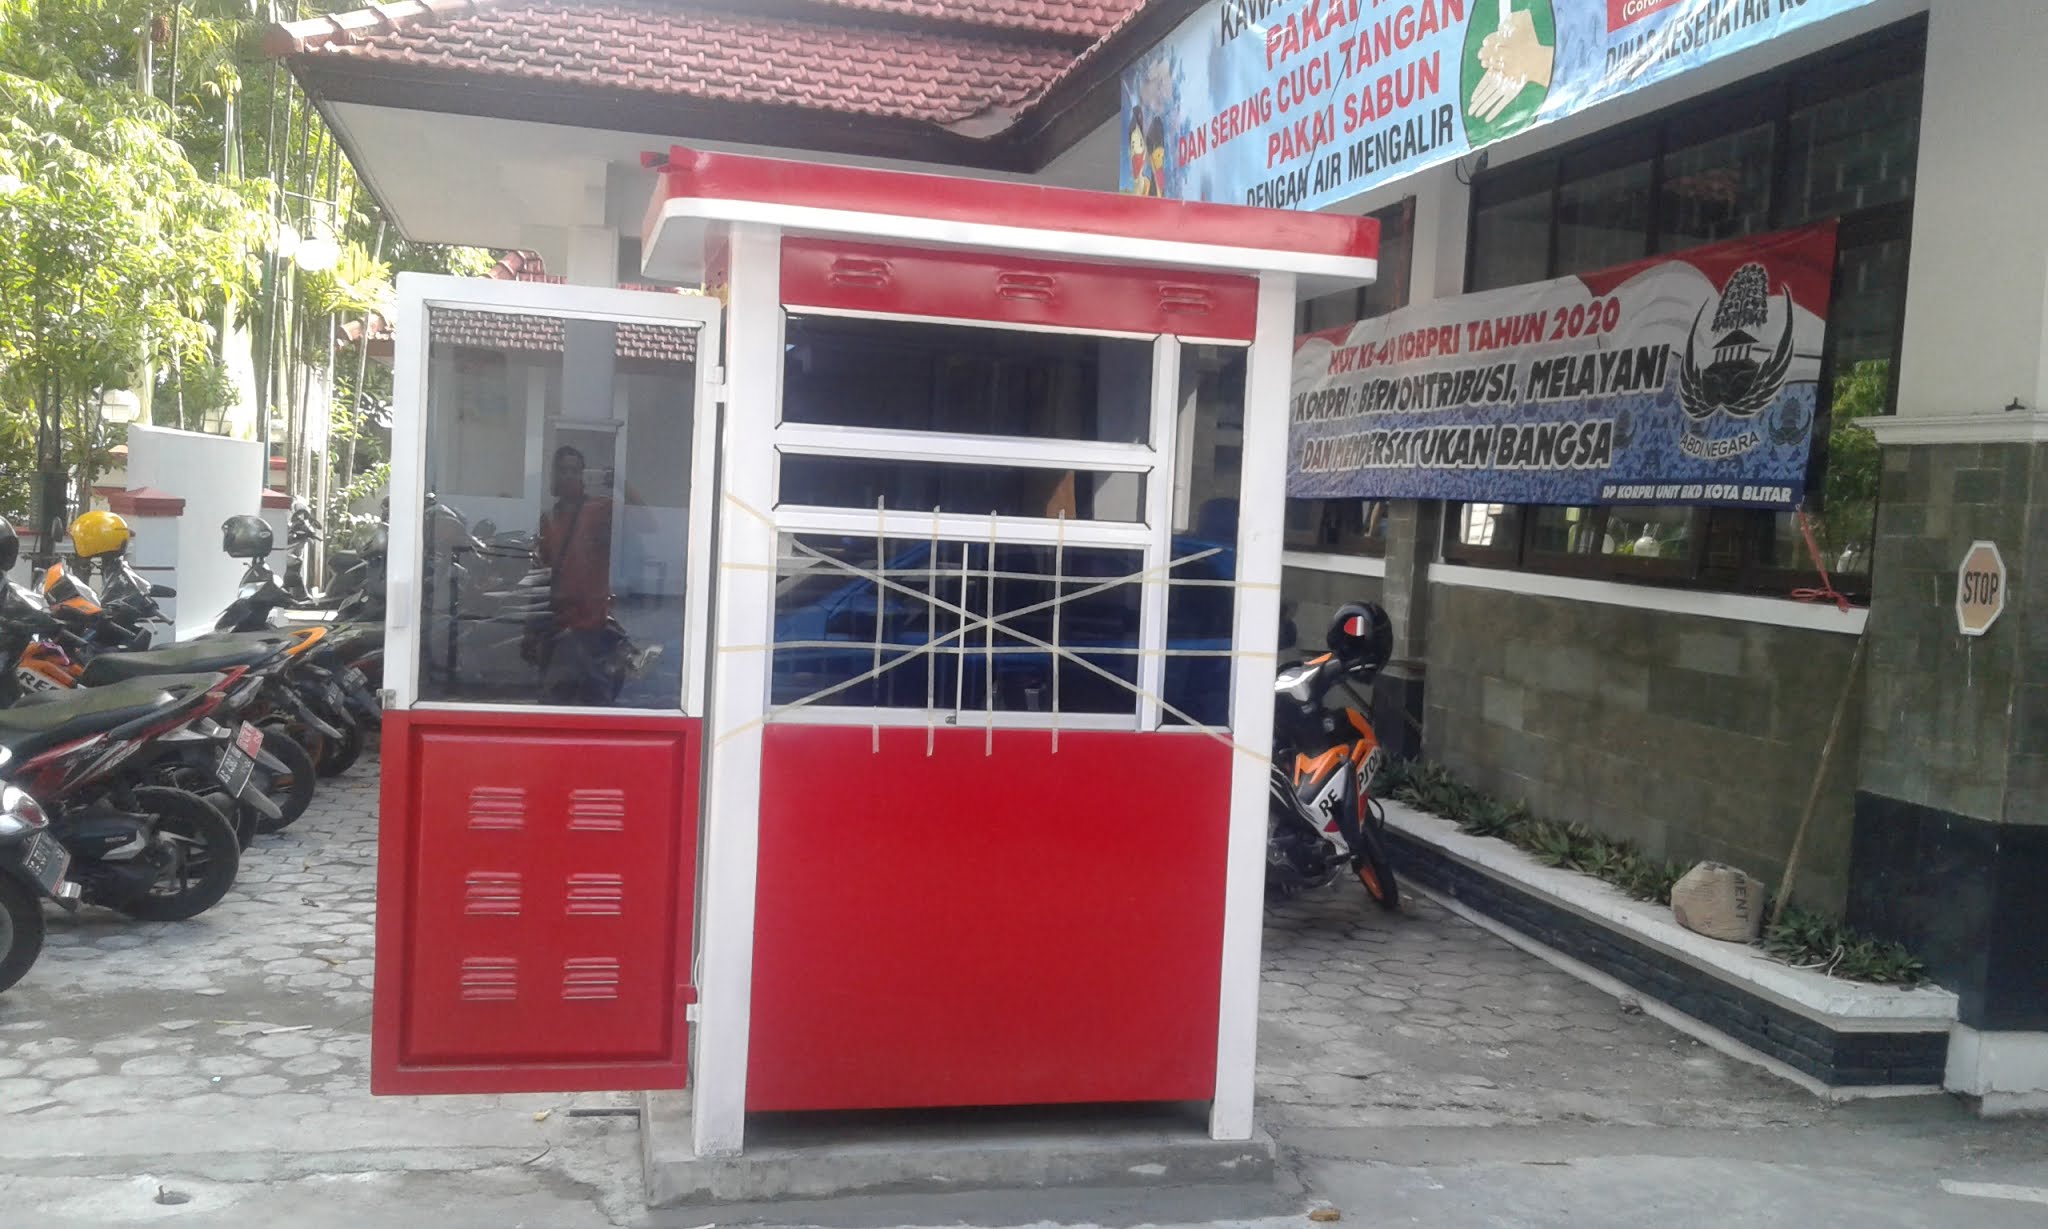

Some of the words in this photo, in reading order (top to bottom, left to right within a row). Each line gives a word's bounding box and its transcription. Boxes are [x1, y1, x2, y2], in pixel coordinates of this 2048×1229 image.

[1266, 0, 1358, 71] PAKAI
[1178, 123, 1207, 167] DAN
[1211, 87, 1273, 149] SERING
[1277, 51, 1332, 111] CUCI
[1339, 0, 1465, 80] TANGAN
[1267, 104, 1335, 169] PAKAI
[1344, 50, 1440, 134] SABUN
[1247, 167, 1310, 208] DENGAN
[1313, 151, 1342, 196] AIR
[1348, 103, 1454, 180] MENGALIR
[1398, 322, 1461, 362] KORPRI
[1467, 310, 1548, 352] TAHUN
[1550, 296, 1621, 342] 2020
[1527, 343, 1670, 400] MELAYANI
[1302, 439, 1333, 470] DAN
[1496, 422, 1613, 467] BANGSA
[1680, 433, 1704, 455] ABDI
[1705, 431, 1760, 457] NEGARA
[1617, 485, 1654, 499] KORPRI
[1656, 485, 1680, 499] UNIT
[1680, 485, 1703, 499] BKD
[1704, 485, 1739, 500] KOTA
[1742, 486, 1792, 503] BLITAR
[1963, 570, 1999, 606] STOP
